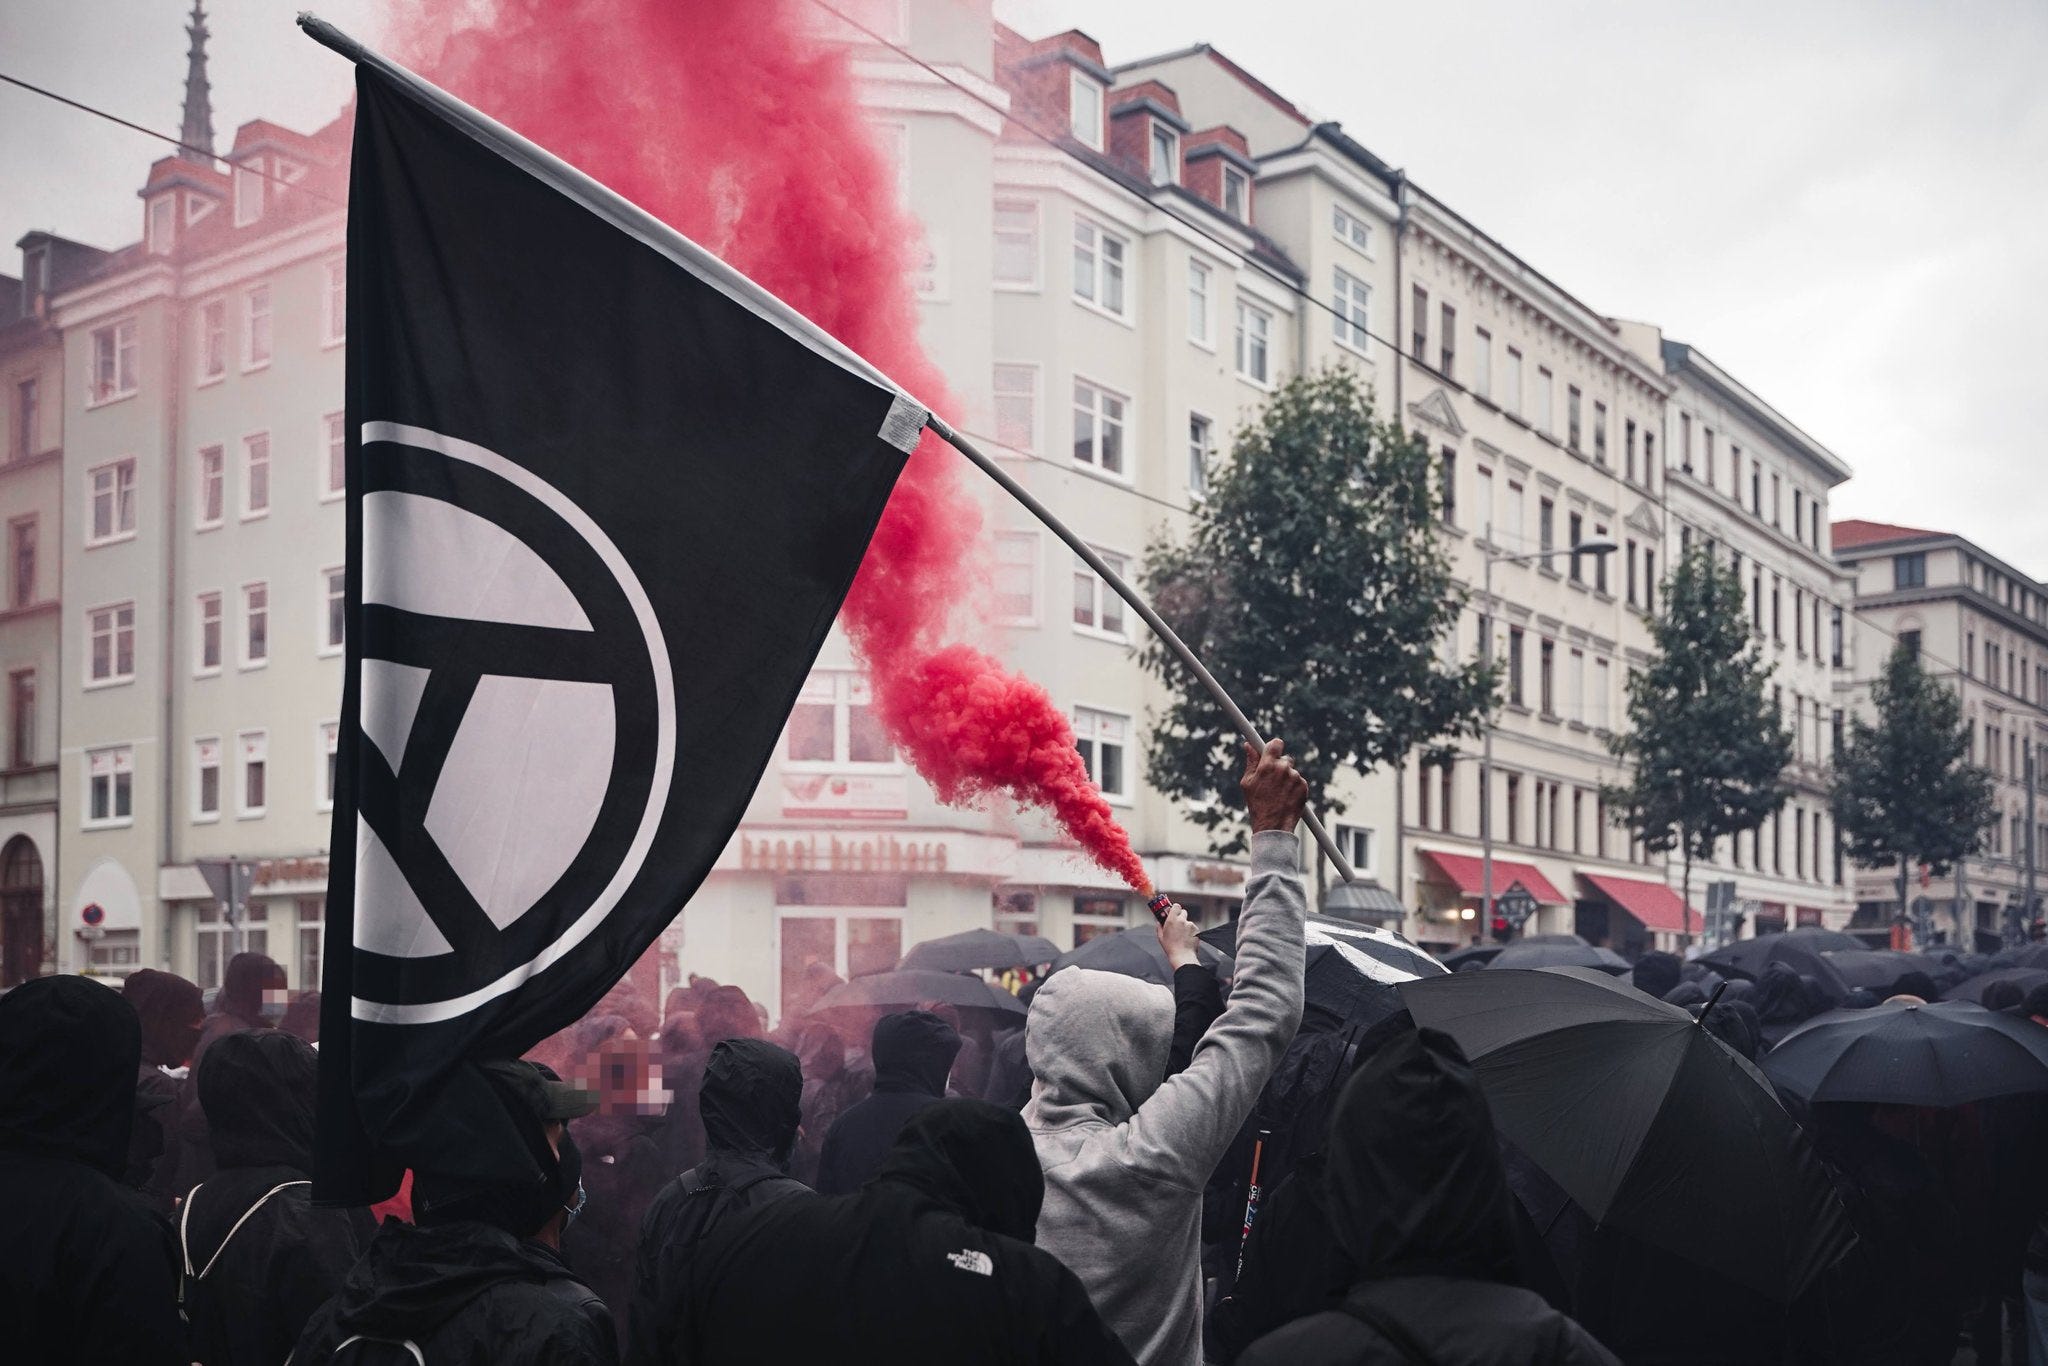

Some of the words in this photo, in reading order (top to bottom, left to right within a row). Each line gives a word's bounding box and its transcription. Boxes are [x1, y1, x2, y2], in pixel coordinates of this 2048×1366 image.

[947, 1253, 979, 1265] NORTH
[963, 1249, 979, 1260] THE
[955, 1260, 980, 1272] FACE
